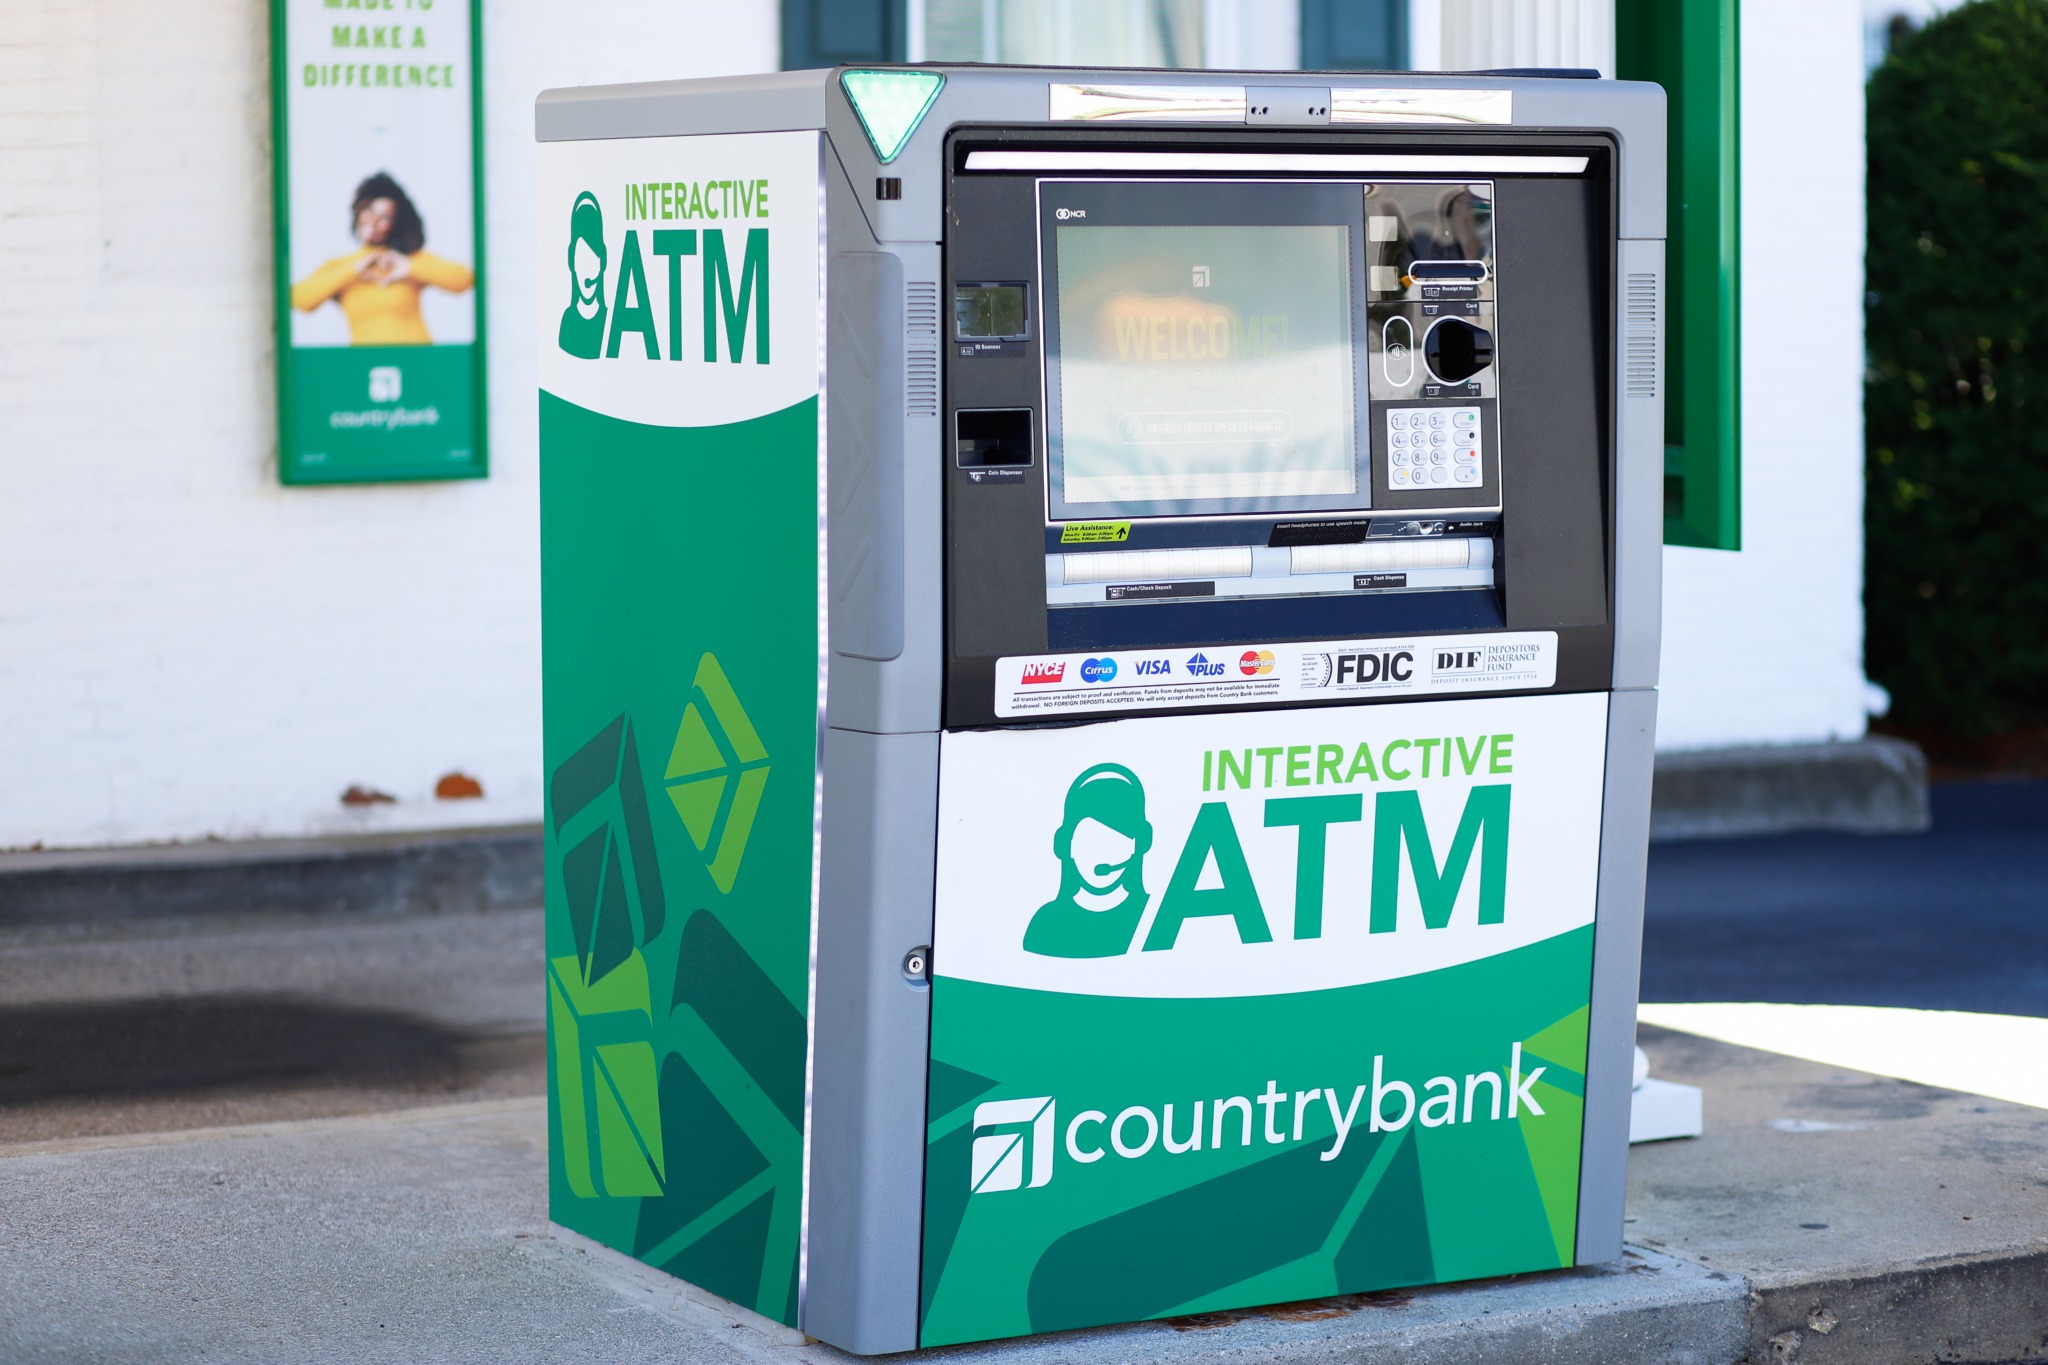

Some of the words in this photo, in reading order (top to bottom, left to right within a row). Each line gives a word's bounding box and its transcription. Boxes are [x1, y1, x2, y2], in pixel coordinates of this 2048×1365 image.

[332, 25, 402, 48] MAKE
[412, 26, 426, 48] A
[303, 63, 454, 88] DIFFERENCE
[626, 179, 769, 220] INTERACTIVE
[1070, 210, 1086, 218] NCR
[605, 228, 770, 365] ATM
[1113, 314, 1290, 362] WELCOME!
[1414, 417, 1419, 426] 2
[1432, 417, 1437, 425] 3
[1395, 436, 1401, 444] 4
[1414, 435, 1419, 444] 5
[1433, 435, 1438, 443] 6
[1396, 454, 1401, 462] 7
[1414, 453, 1420, 462] 8
[1433, 453, 1439, 461] 9
[1488, 644, 1541, 654] DEPOSITORS
[1240, 659, 1276, 668] MasterCard
[1436, 651, 1481, 670] DIF
[1488, 653, 1536, 663] INSURANCE
[1024, 662, 1064, 677] NYCE
[1084, 666, 1113, 675] Cirrus
[1134, 660, 1171, 675] VISA
[1196, 663, 1225, 677] PLUS
[1337, 651, 1414, 684] FDIC
[1487, 662, 1512, 671] FUND
[1202, 734, 1514, 791] INTERACTIVE
[1141, 783, 1512, 953] ATM
[1065, 1042, 1547, 1162] countrybank
